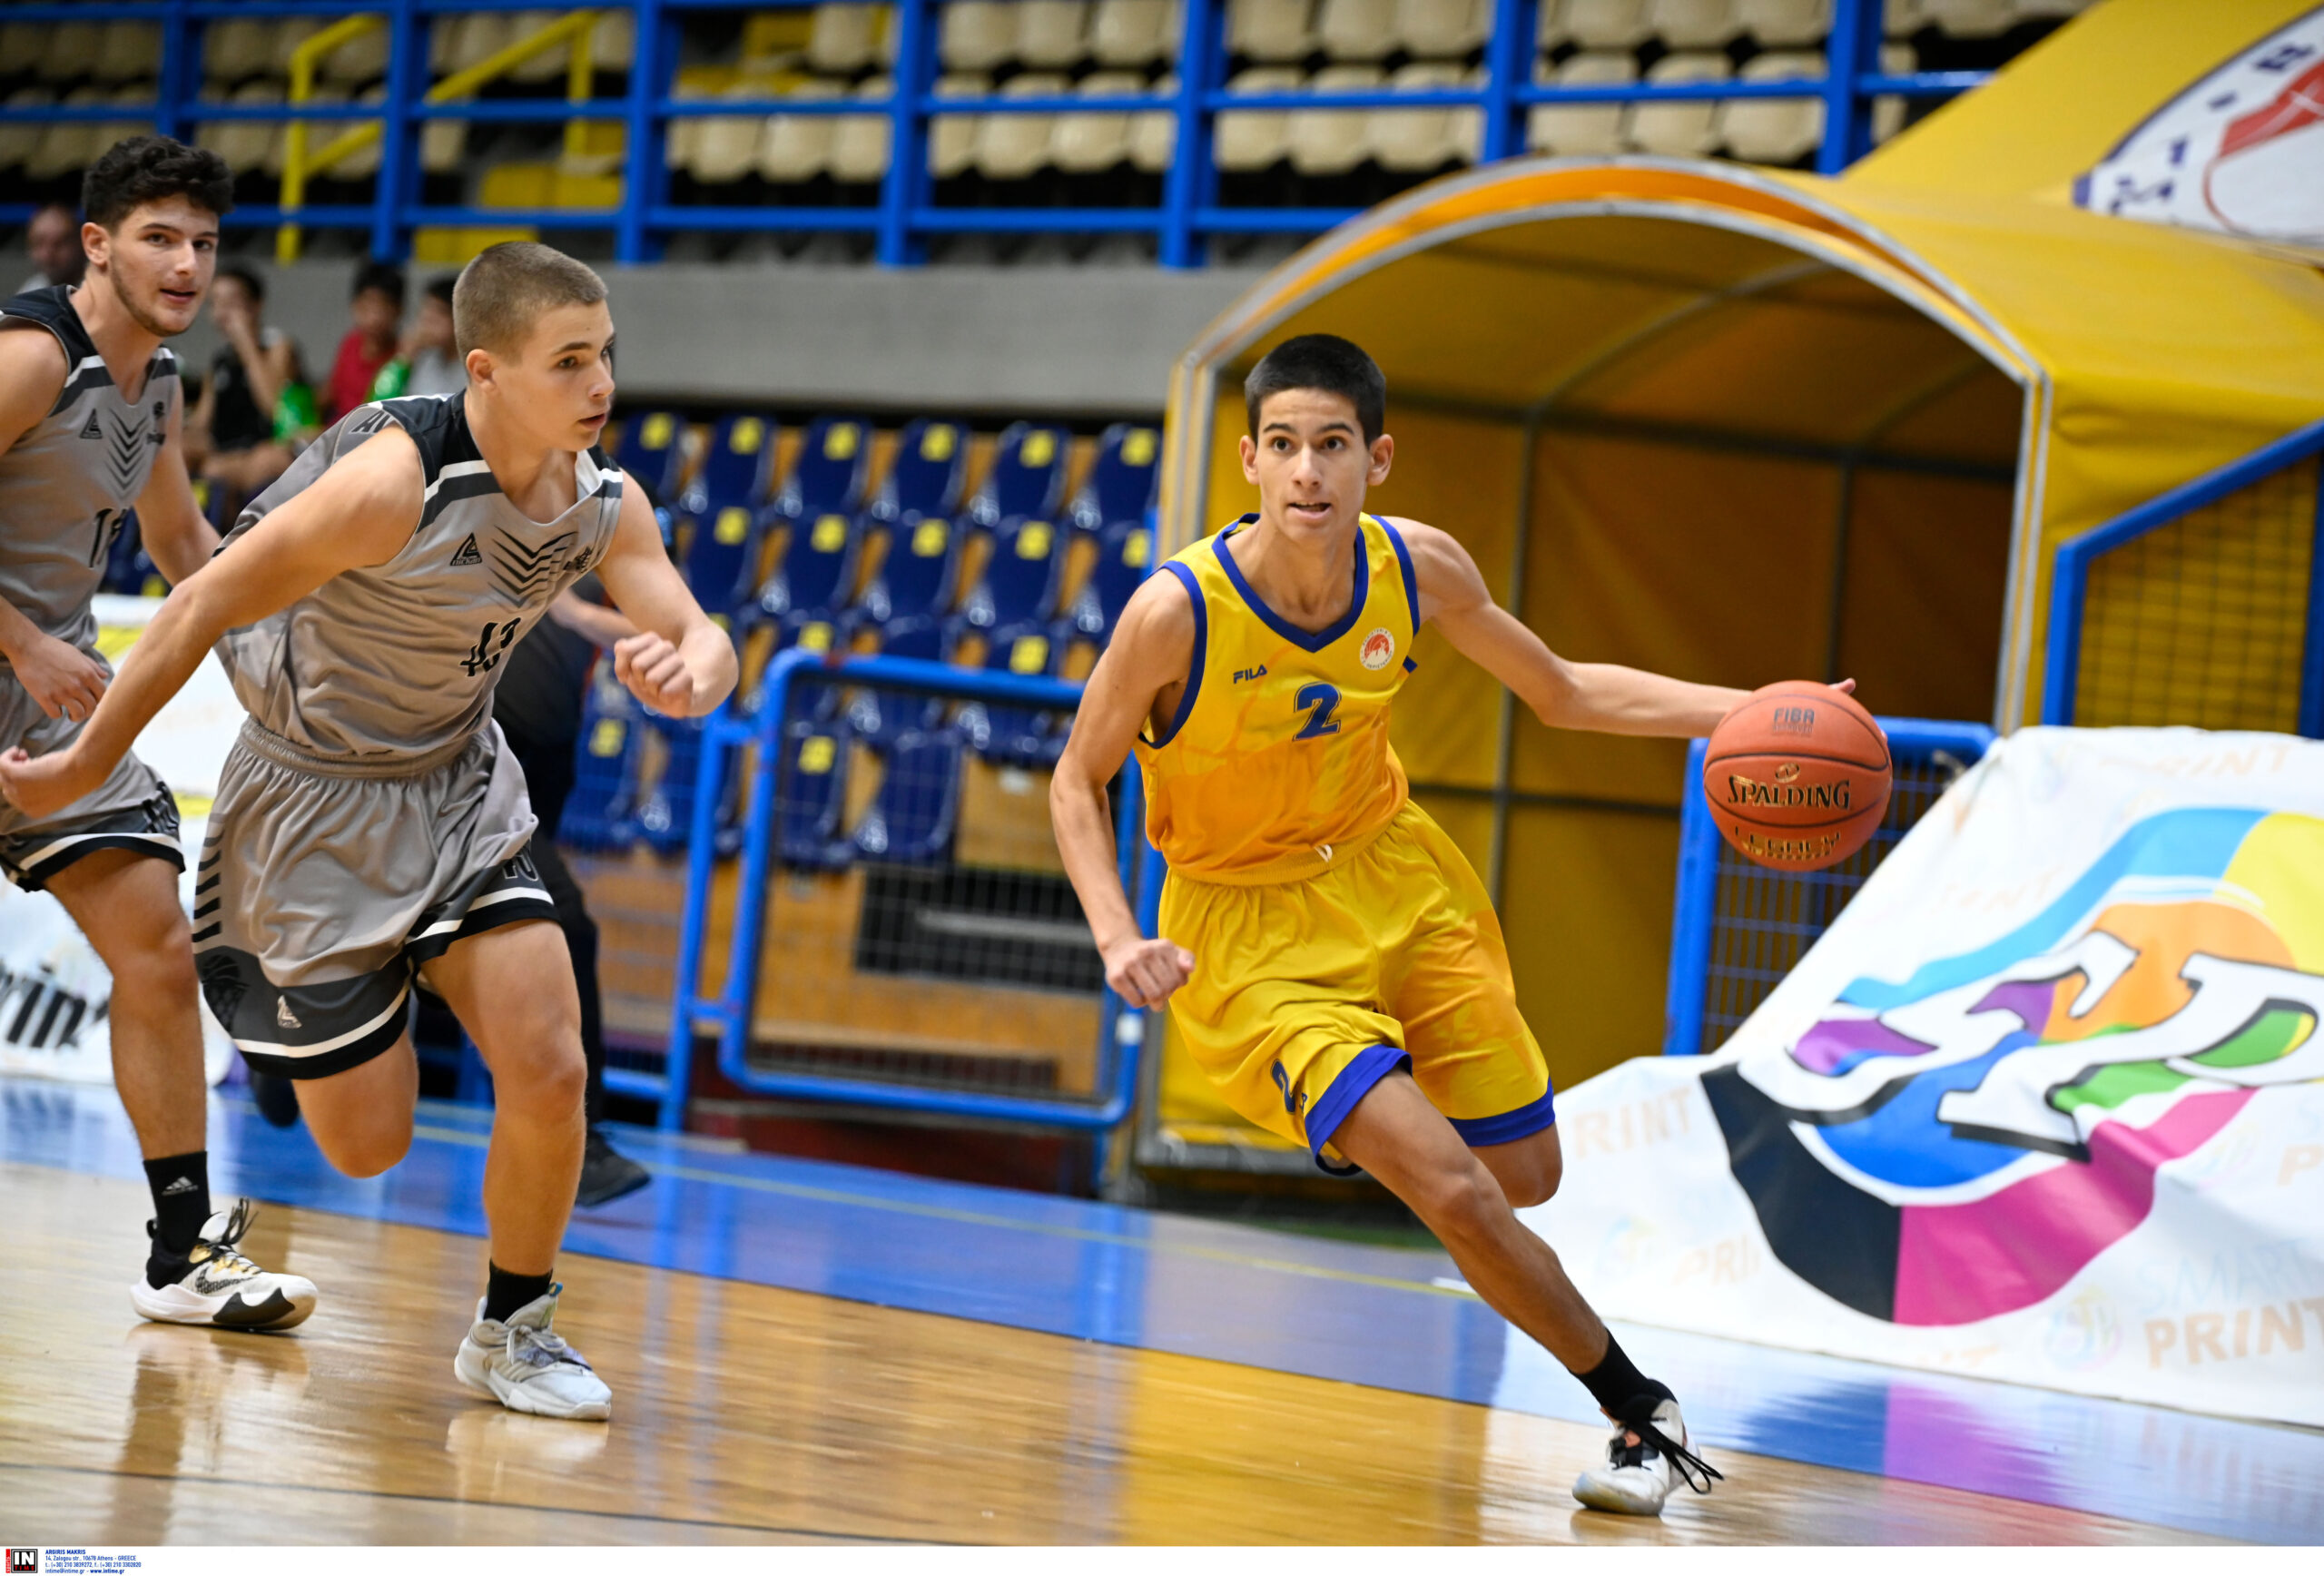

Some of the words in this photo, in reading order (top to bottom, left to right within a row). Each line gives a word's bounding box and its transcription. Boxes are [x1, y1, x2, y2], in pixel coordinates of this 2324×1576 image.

[1233, 665, 1268, 684] FILA
[1292, 681, 1342, 742] 2
[1773, 707, 1815, 723] FIBA
[1728, 774, 1851, 810] SPALDING
[1270, 1059, 1296, 1115] 2
[1560, 1087, 1692, 1159] RINT
